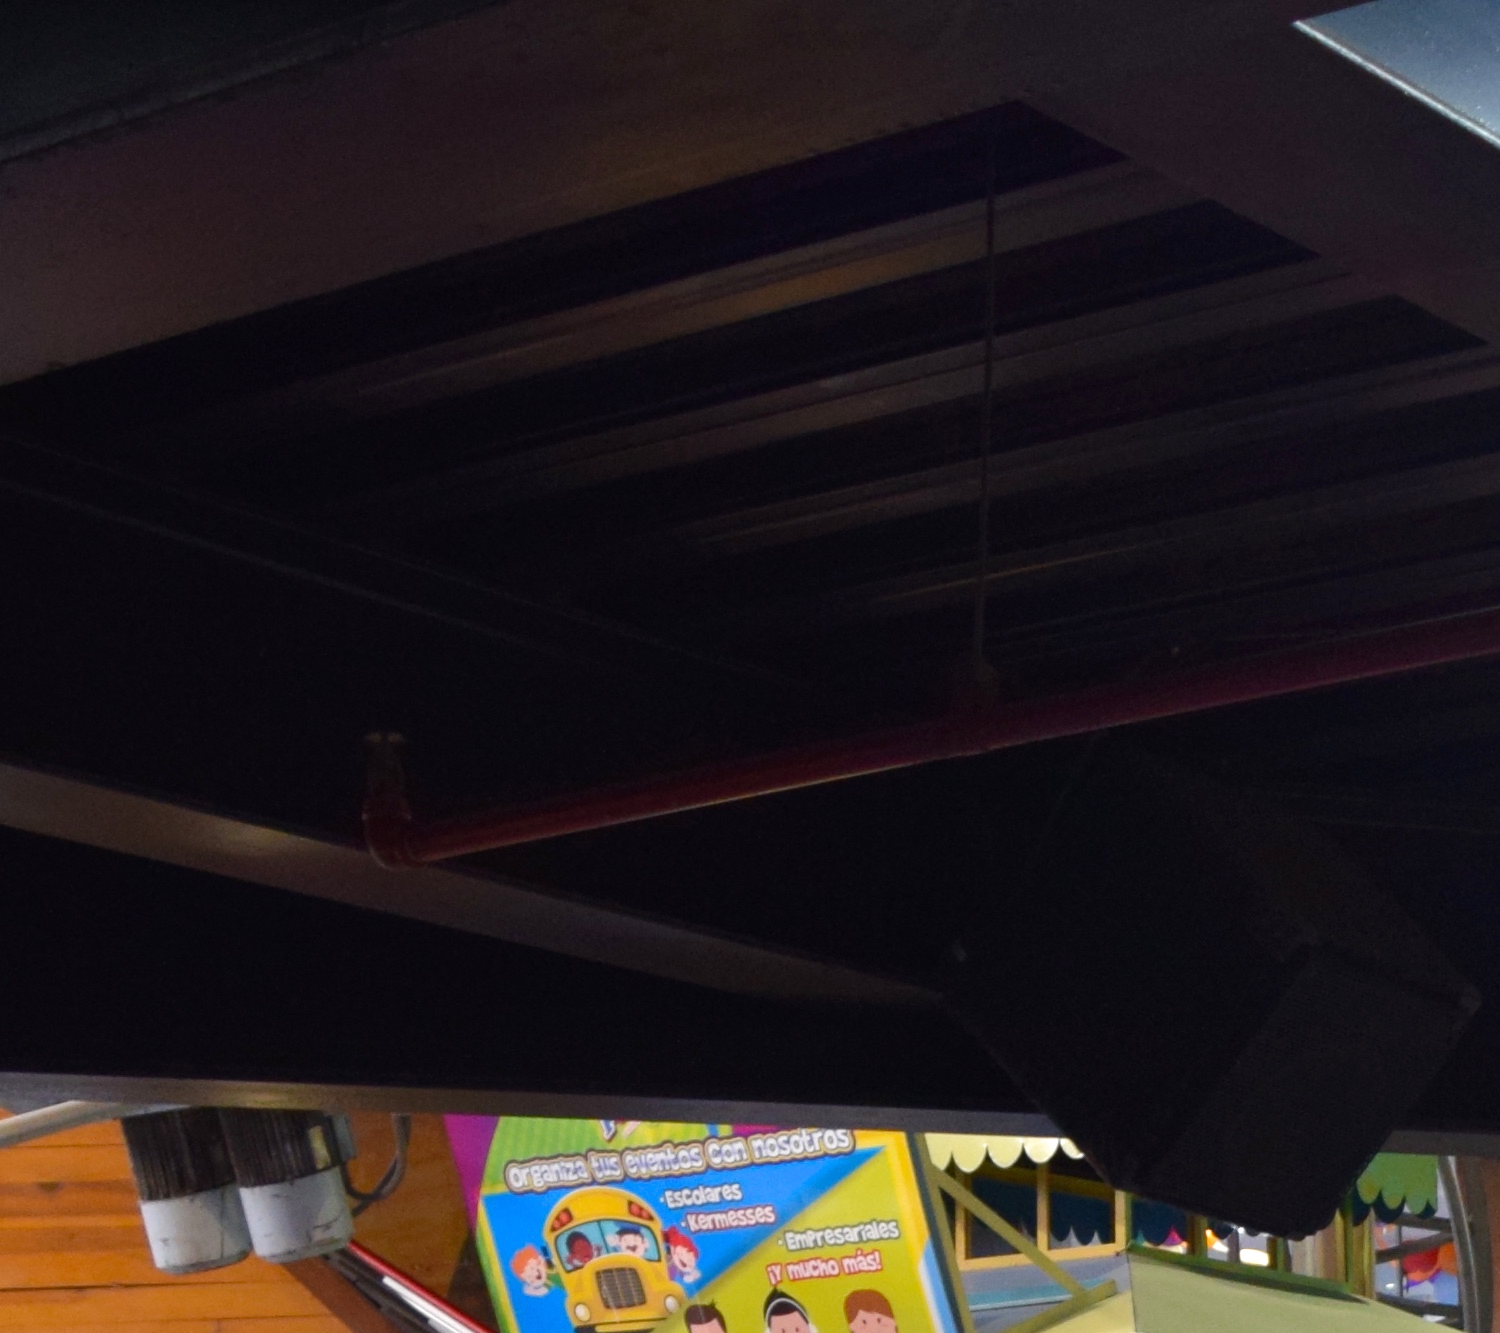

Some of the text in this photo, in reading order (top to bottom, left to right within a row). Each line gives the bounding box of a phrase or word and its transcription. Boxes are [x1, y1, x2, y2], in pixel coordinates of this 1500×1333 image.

[592, 1152, 622, 1178] tus
[625, 1146, 702, 1176] eventos
[753, 1128, 851, 1159] nosotros
[786, 1257, 840, 1281] mucho
[845, 1249, 883, 1275] más!
